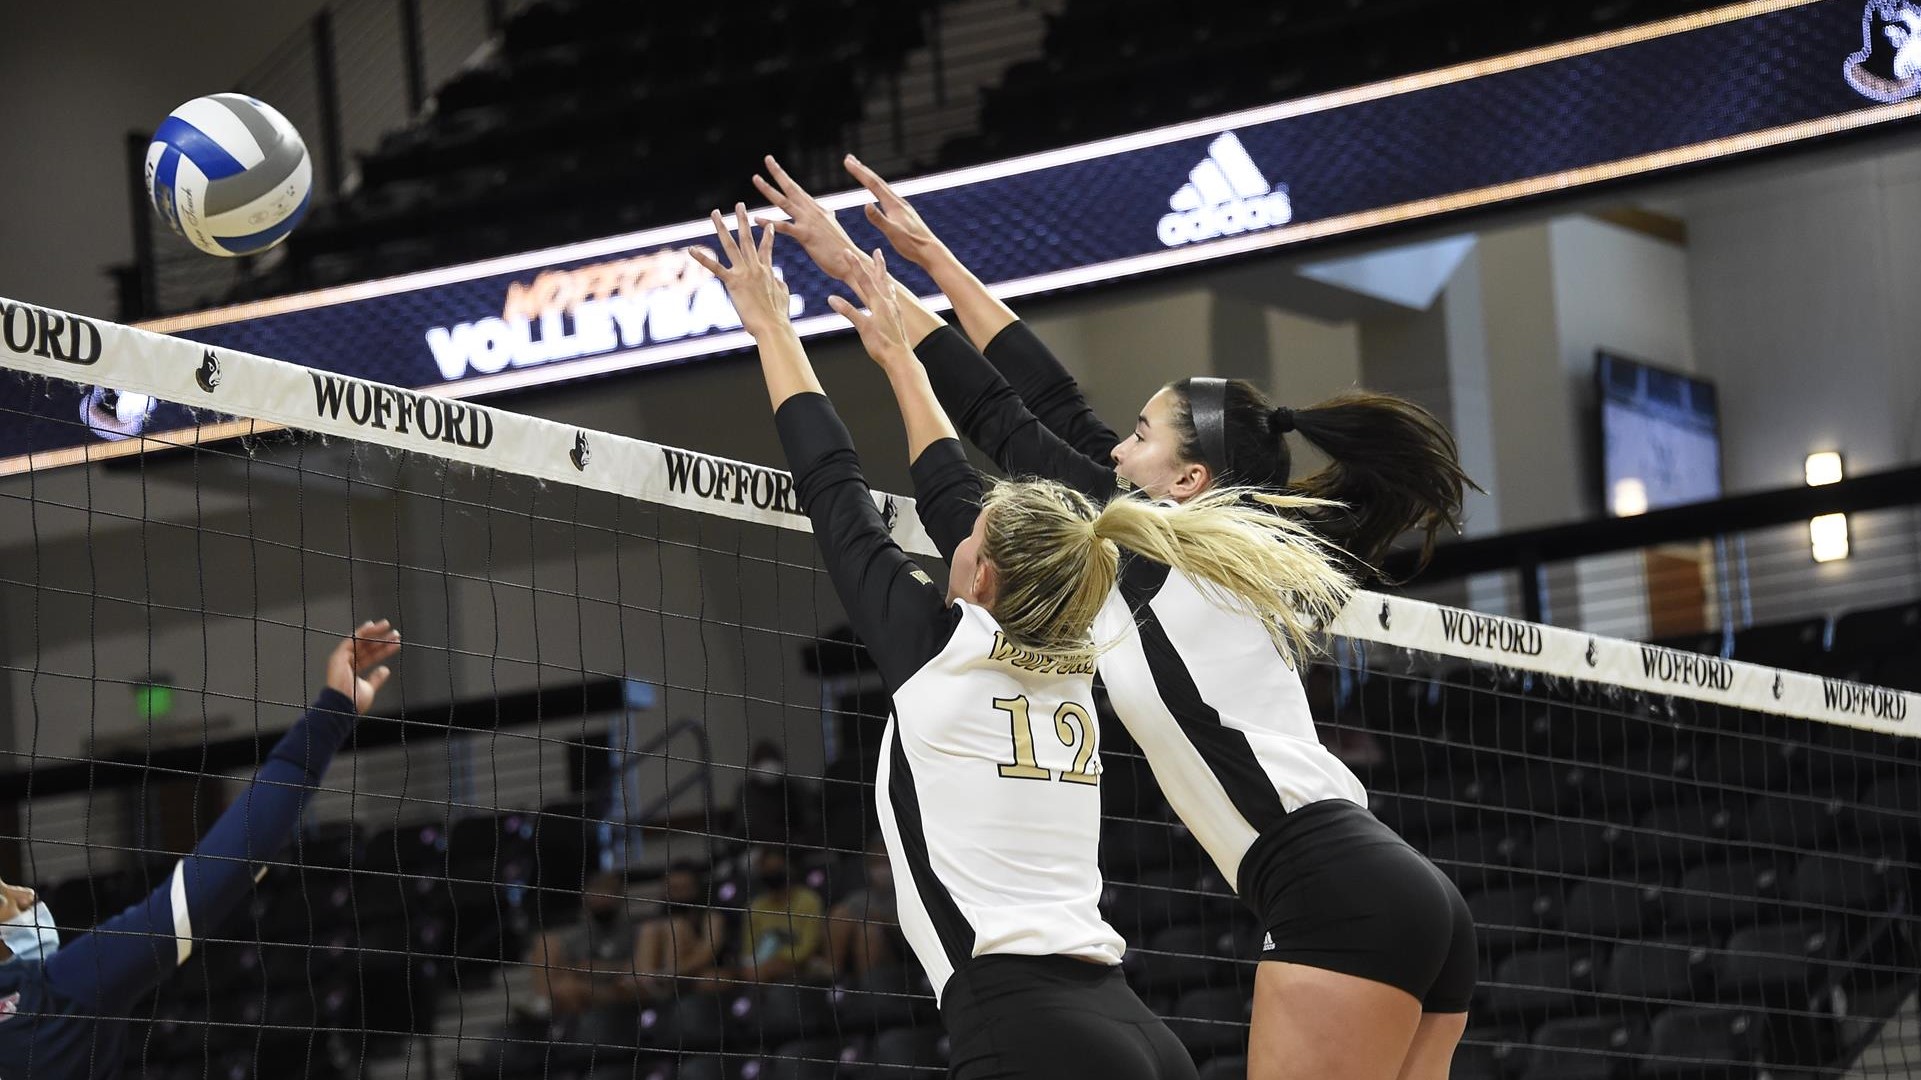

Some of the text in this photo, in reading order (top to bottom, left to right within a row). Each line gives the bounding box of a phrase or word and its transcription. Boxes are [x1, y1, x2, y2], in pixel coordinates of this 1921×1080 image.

[0, 302, 102, 366] ORD
[426, 266, 805, 380] VOLLEYBA
[308, 368, 493, 450] WOFFORD
[662, 448, 808, 516] WOFFOR
[1440, 609, 1542, 656] WOFFORD
[1641, 647, 1733, 691] WOFFORD
[1823, 677, 1906, 721] WOFFORD
[993, 694, 1098, 786] 12
